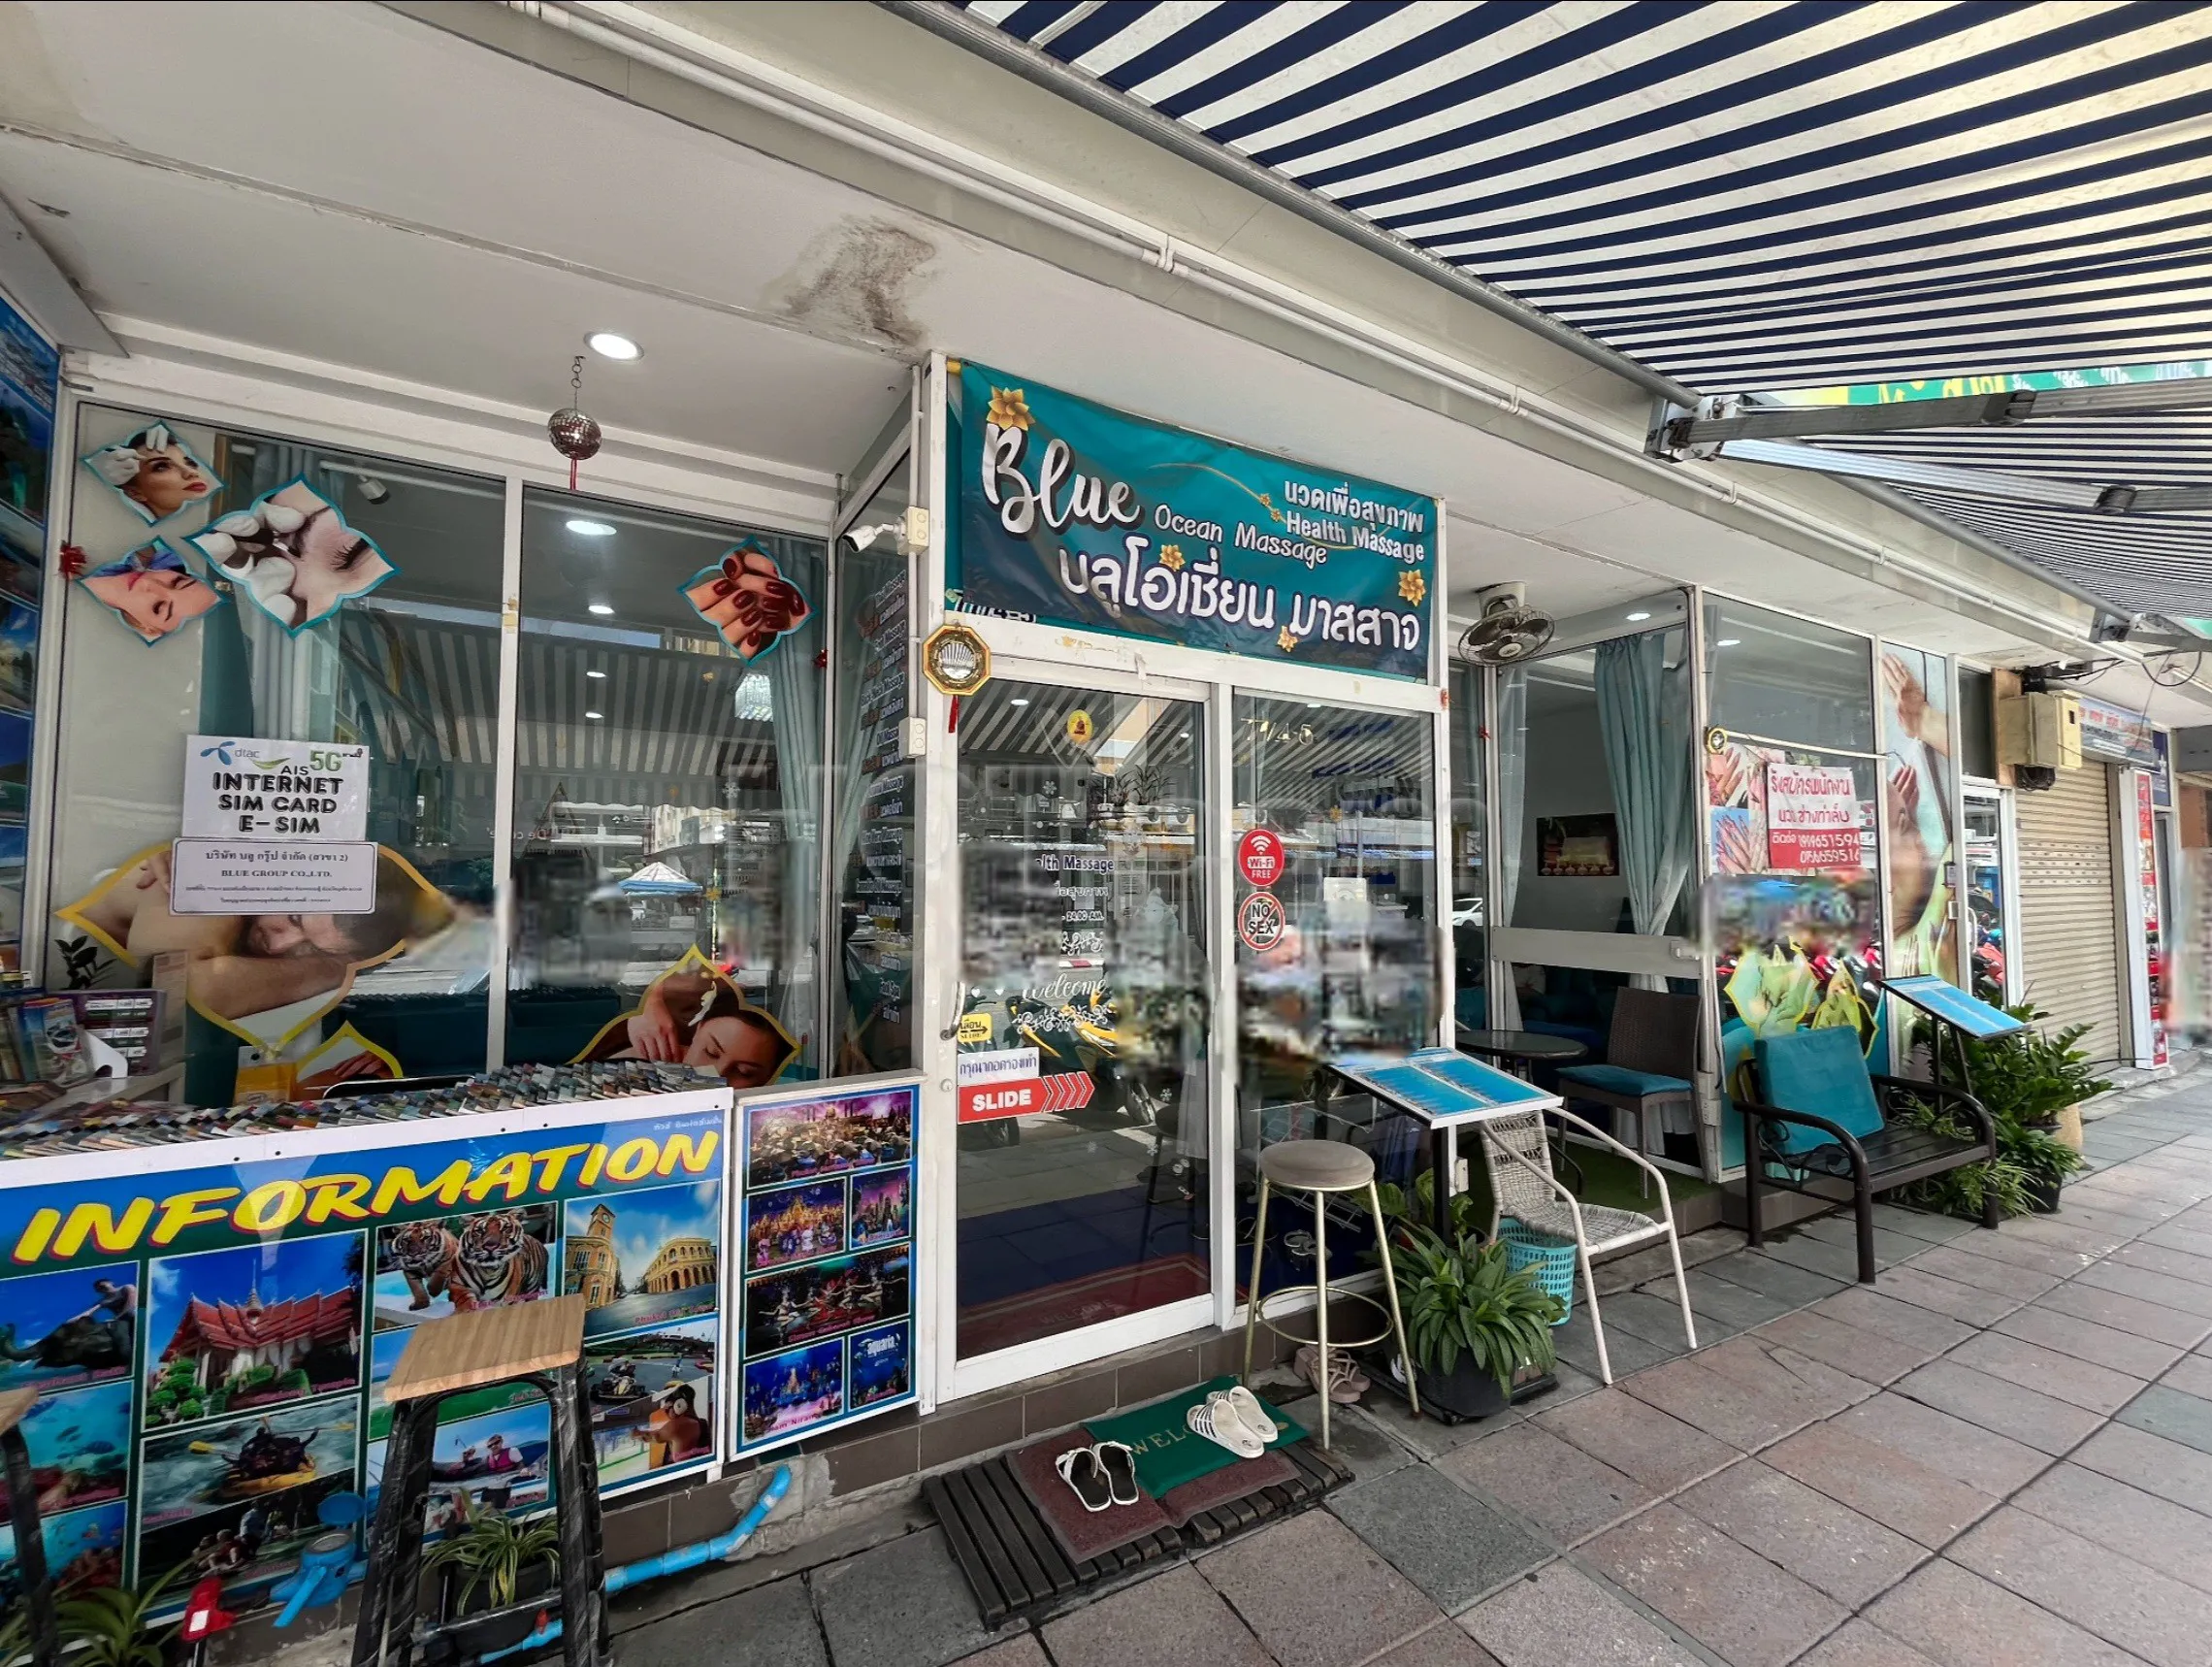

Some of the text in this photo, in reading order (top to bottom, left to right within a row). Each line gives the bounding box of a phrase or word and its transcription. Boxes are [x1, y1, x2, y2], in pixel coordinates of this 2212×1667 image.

[982, 423, 1328, 570] Blue Ocean Massage
[1284, 479, 1424, 534] นวดเพื่อสุขภาพ
[1286, 509, 1425, 565] Health Massage
[1289, 592, 1421, 652] มาสสาจ
[234, 748, 260, 759] dtac
[309, 750, 342, 772] 5G
[280, 765, 309, 776] AIS
[211, 771, 344, 796] INTERNET
[218, 794, 338, 814] SIM CARD
[1063, 854, 1115, 875] Massage
[1250, 859, 1275, 869] Wi-Fi
[1252, 868, 1272, 879] FREE
[1252, 902, 1270, 919] NO
[1248, 920, 1276, 935] SEX
[972, 1089, 1032, 1112] SLIDE
[11, 1129, 722, 1265] INFORMATION
[1132, 1424, 1193, 1455] WELC
